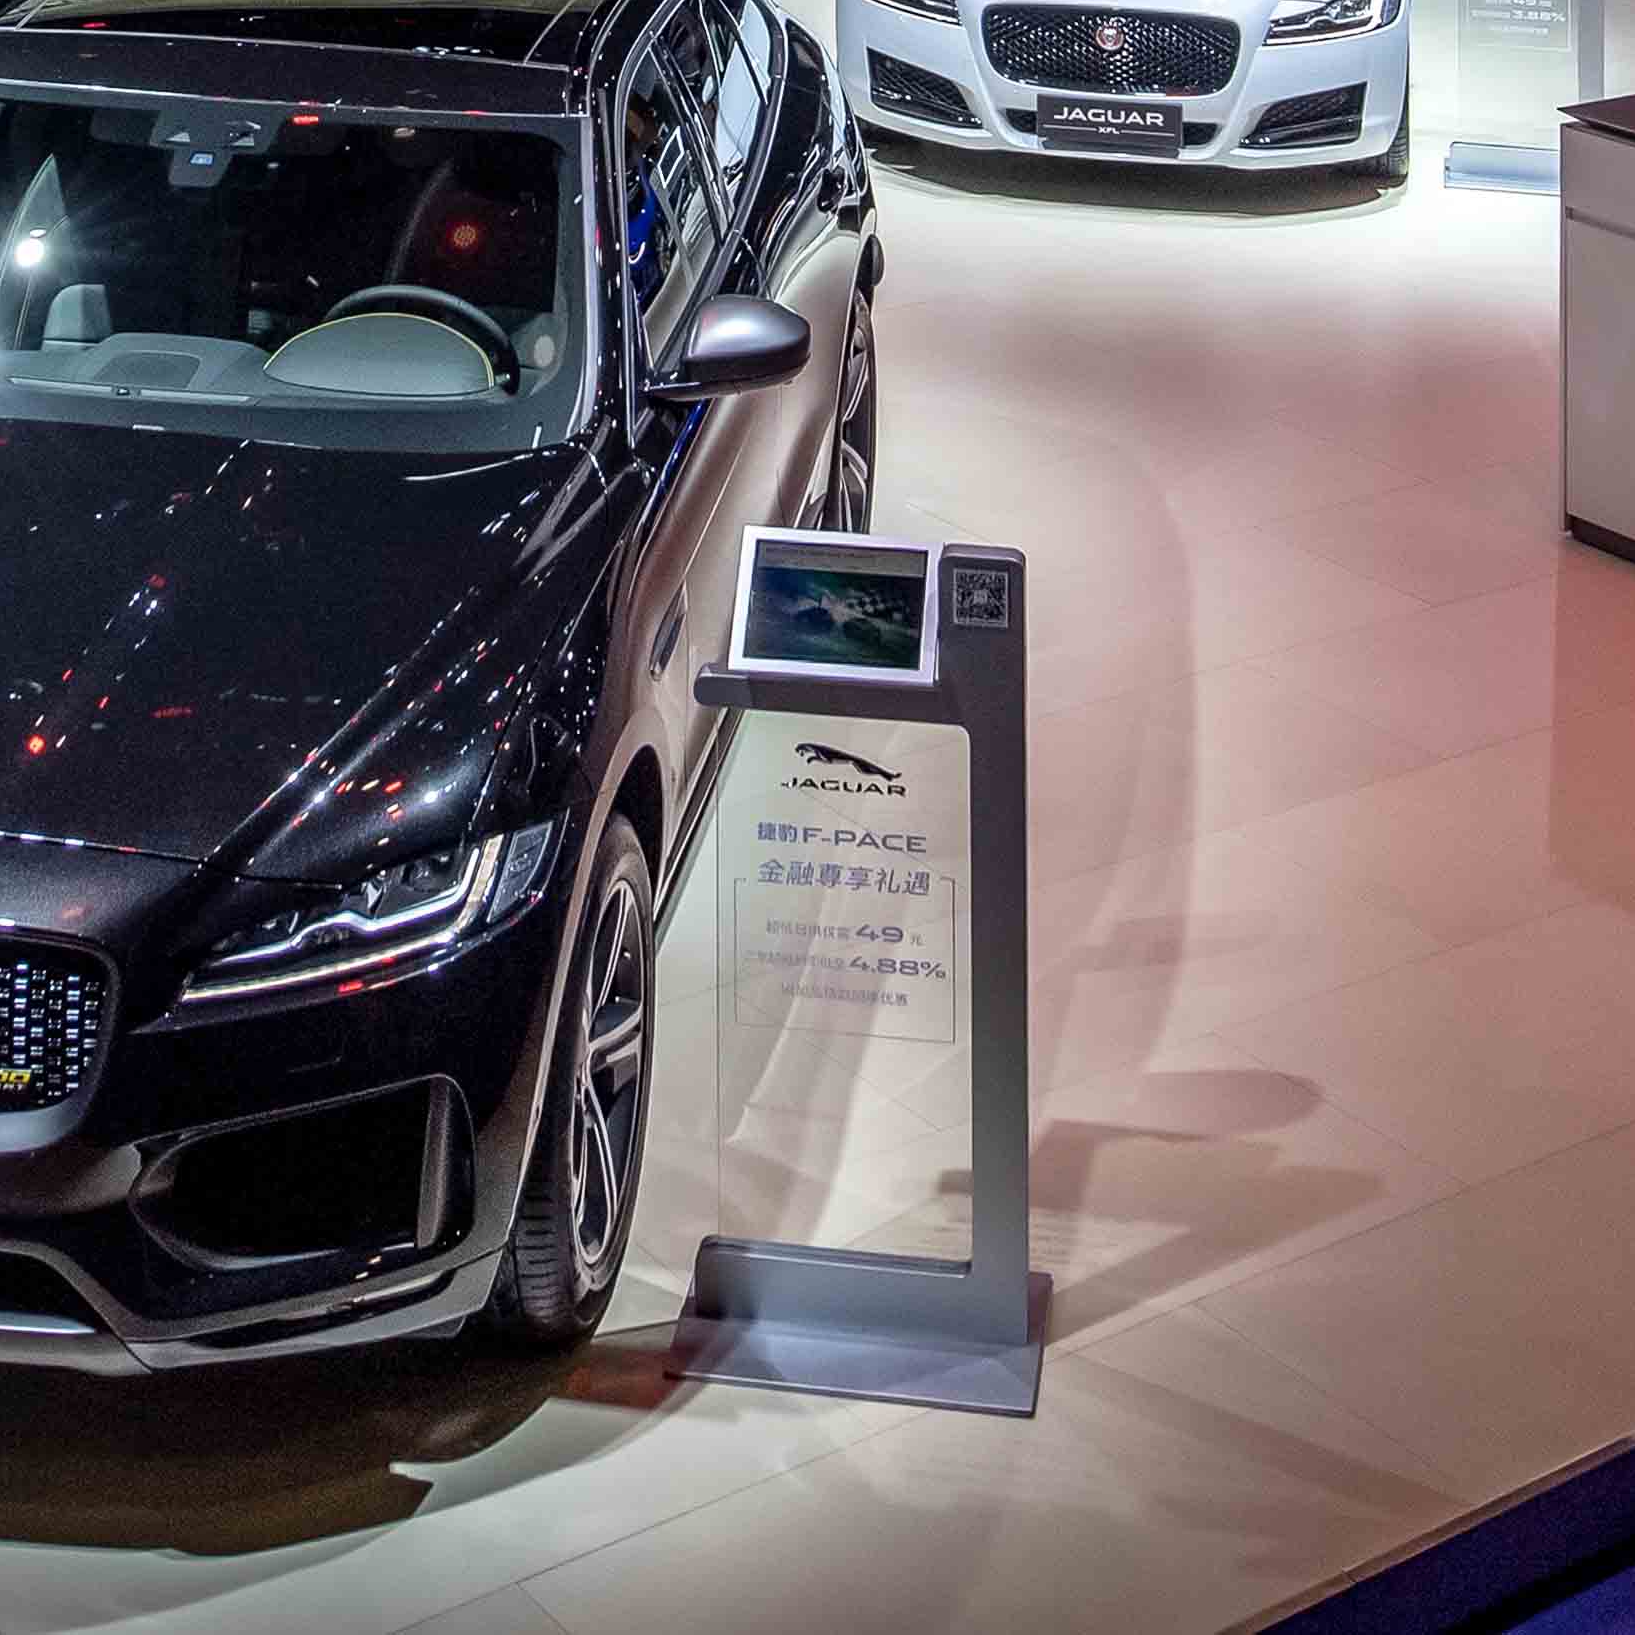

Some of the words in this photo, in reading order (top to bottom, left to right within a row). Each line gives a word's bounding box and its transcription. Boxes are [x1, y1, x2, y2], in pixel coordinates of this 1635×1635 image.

[1053, 106, 1165, 127] JAGUAR
[1098, 126, 1121, 135] XFL
[780, 777, 907, 797] JAGUAR
[757, 858, 931, 897] 金融尊享礼遇
[855, 923, 904, 943] 49
[849, 955, 947, 979] 4.88%
